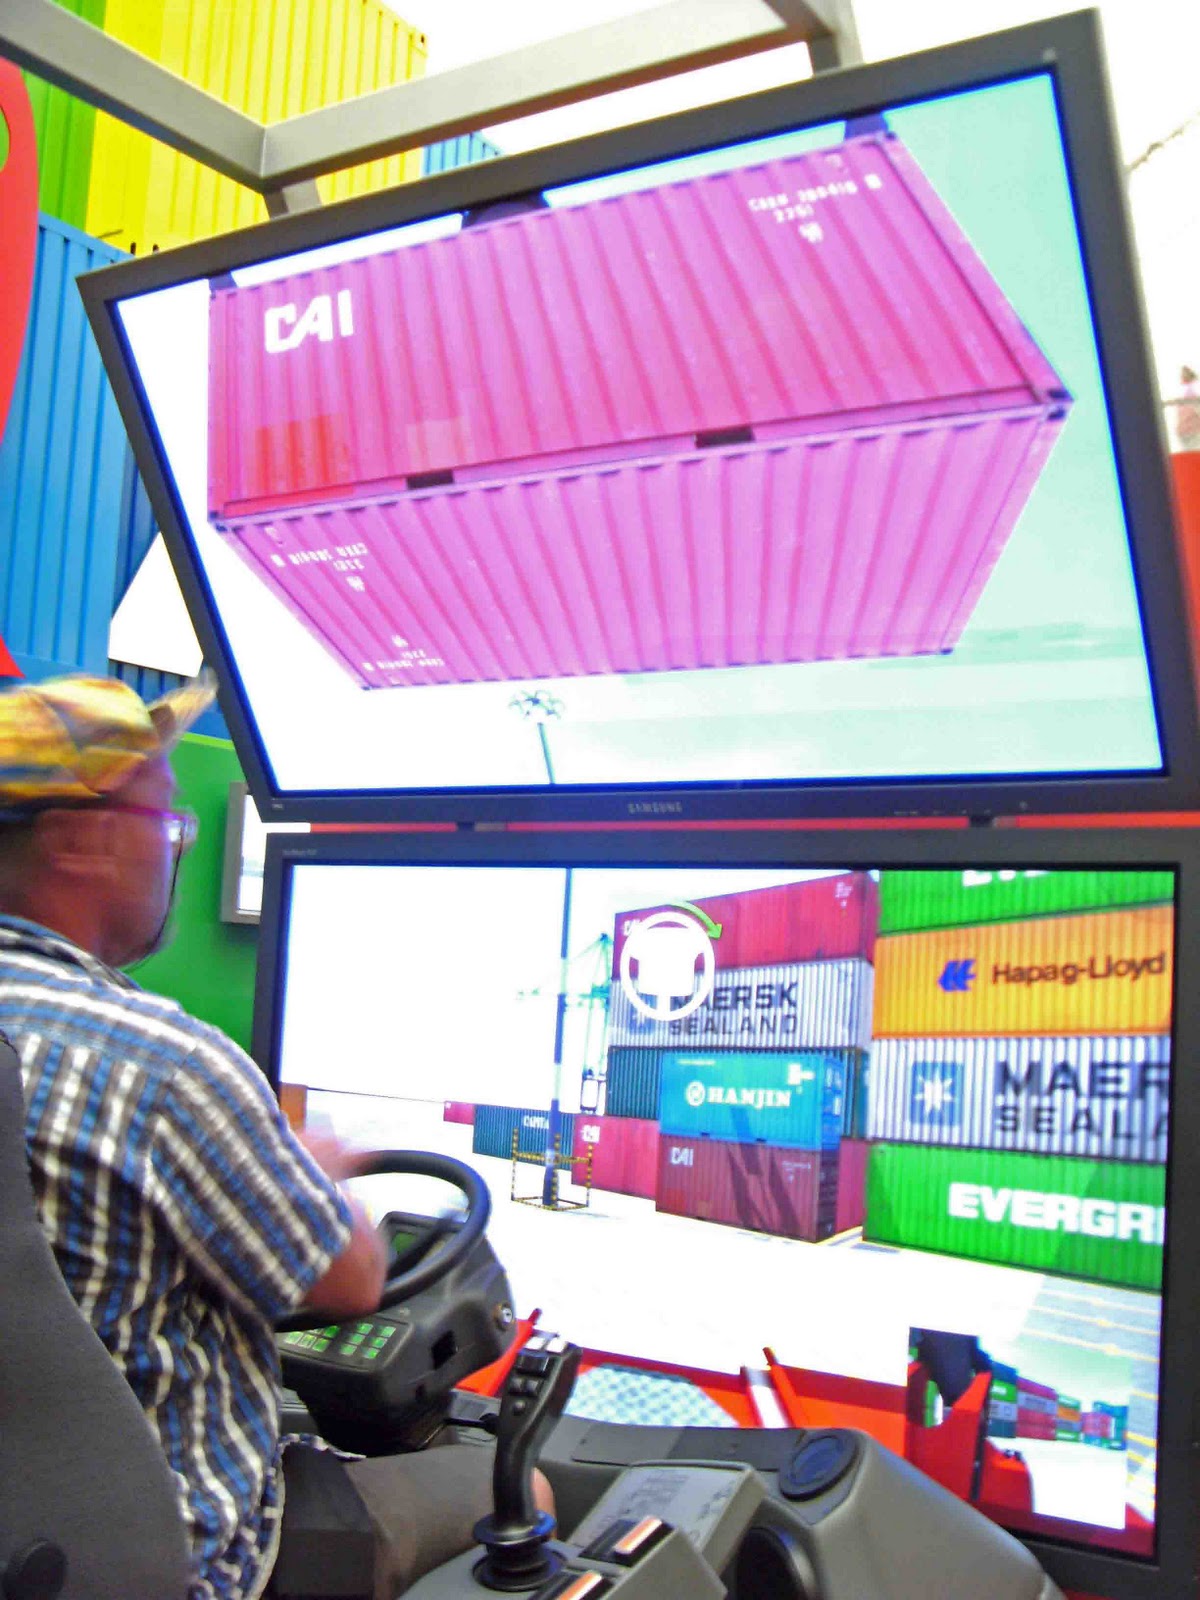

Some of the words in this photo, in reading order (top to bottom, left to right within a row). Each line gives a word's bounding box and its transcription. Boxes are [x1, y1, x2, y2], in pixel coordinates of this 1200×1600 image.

[264, 289, 354, 353] CAI
[991, 953, 1166, 987] Hapag-Lloyd
[708, 1086, 792, 1109] HANJIN
[948, 1182, 1165, 1244] EVERGR
